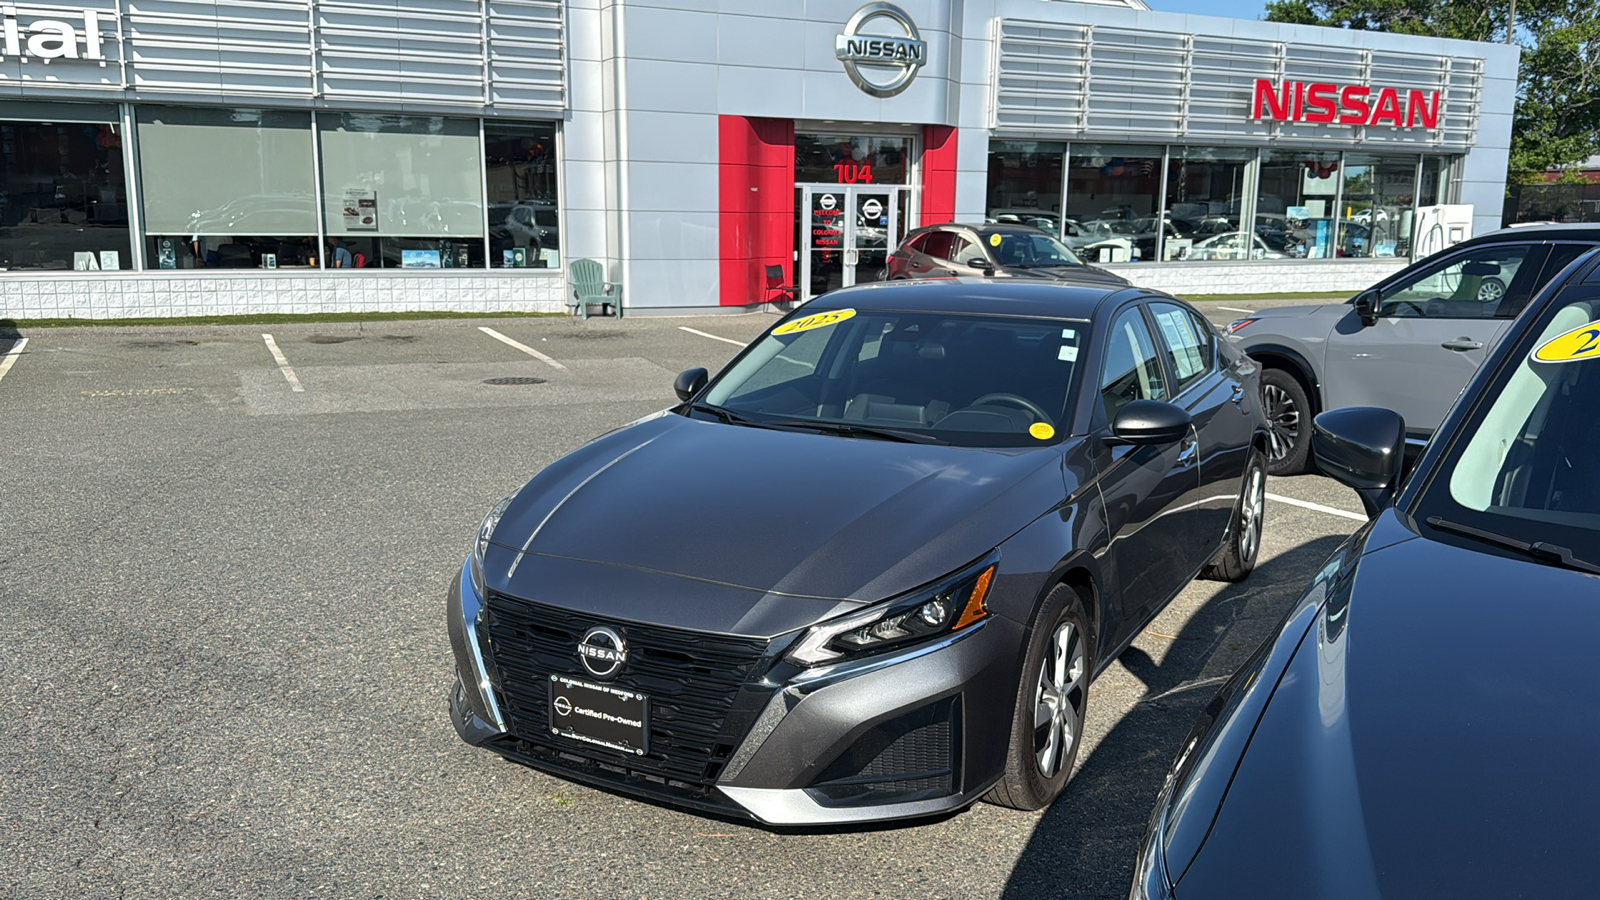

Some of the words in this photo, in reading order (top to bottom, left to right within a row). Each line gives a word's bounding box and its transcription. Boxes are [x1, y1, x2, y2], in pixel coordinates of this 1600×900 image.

[847, 39, 920, 60] NISSAN
[1252, 78, 1440, 129] NISSAN
[833, 164, 873, 184] 104
[578, 644, 626, 661] NISSAN
[583, 683, 602, 692] NISSAN
[574, 706, 602, 719] Certified
[603, 711, 641, 728] Pre-Owned
